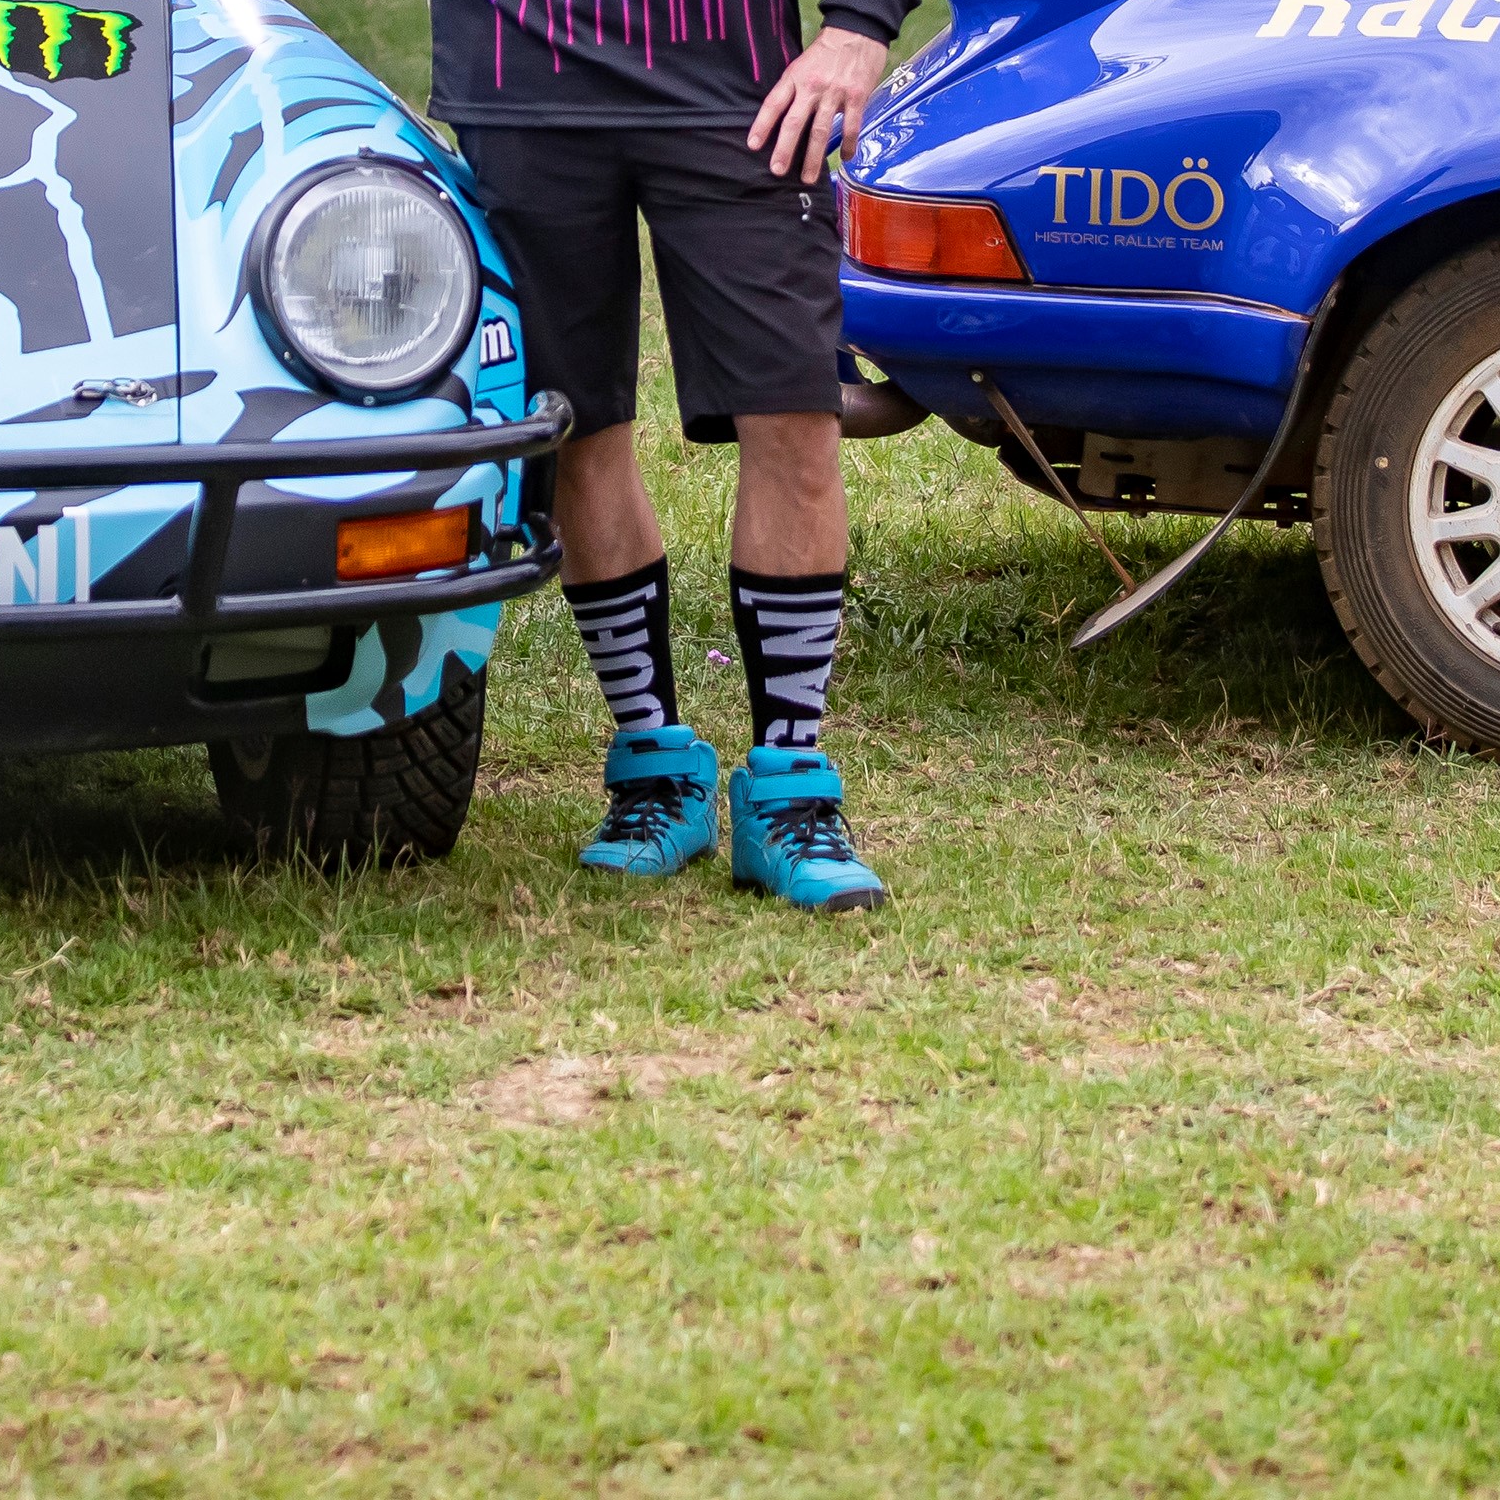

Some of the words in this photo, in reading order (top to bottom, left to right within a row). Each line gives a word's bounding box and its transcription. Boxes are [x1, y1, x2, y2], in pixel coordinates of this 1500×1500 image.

[1038, 157, 1225, 231] TIDÖ
[1035, 231, 1109, 246] HISTORIC
[1114, 233, 1176, 249] RALLYE
[1180, 237, 1224, 251] TEAM
